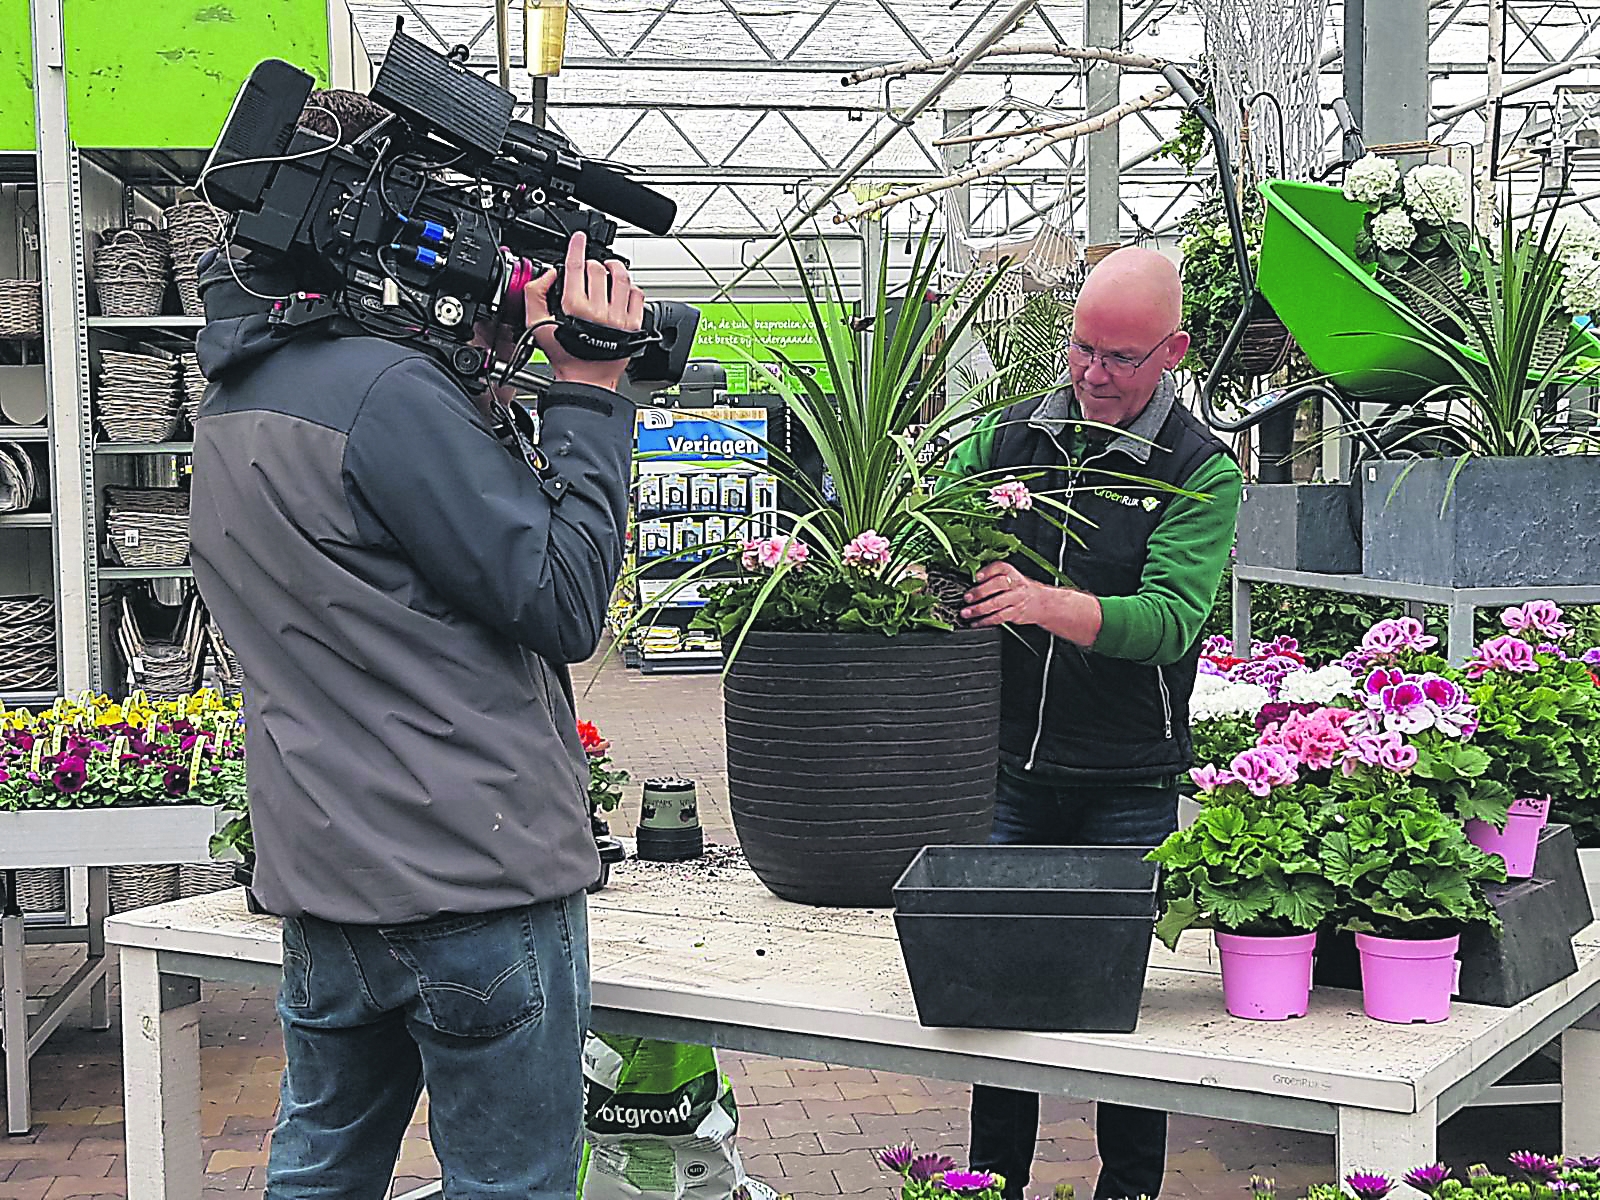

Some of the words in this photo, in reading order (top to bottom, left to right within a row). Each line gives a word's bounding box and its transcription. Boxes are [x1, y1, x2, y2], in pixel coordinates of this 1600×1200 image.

[719, 317, 730, 329] de
[579, 333, 618, 351] Canon
[667, 434, 759, 459] Verjagen
